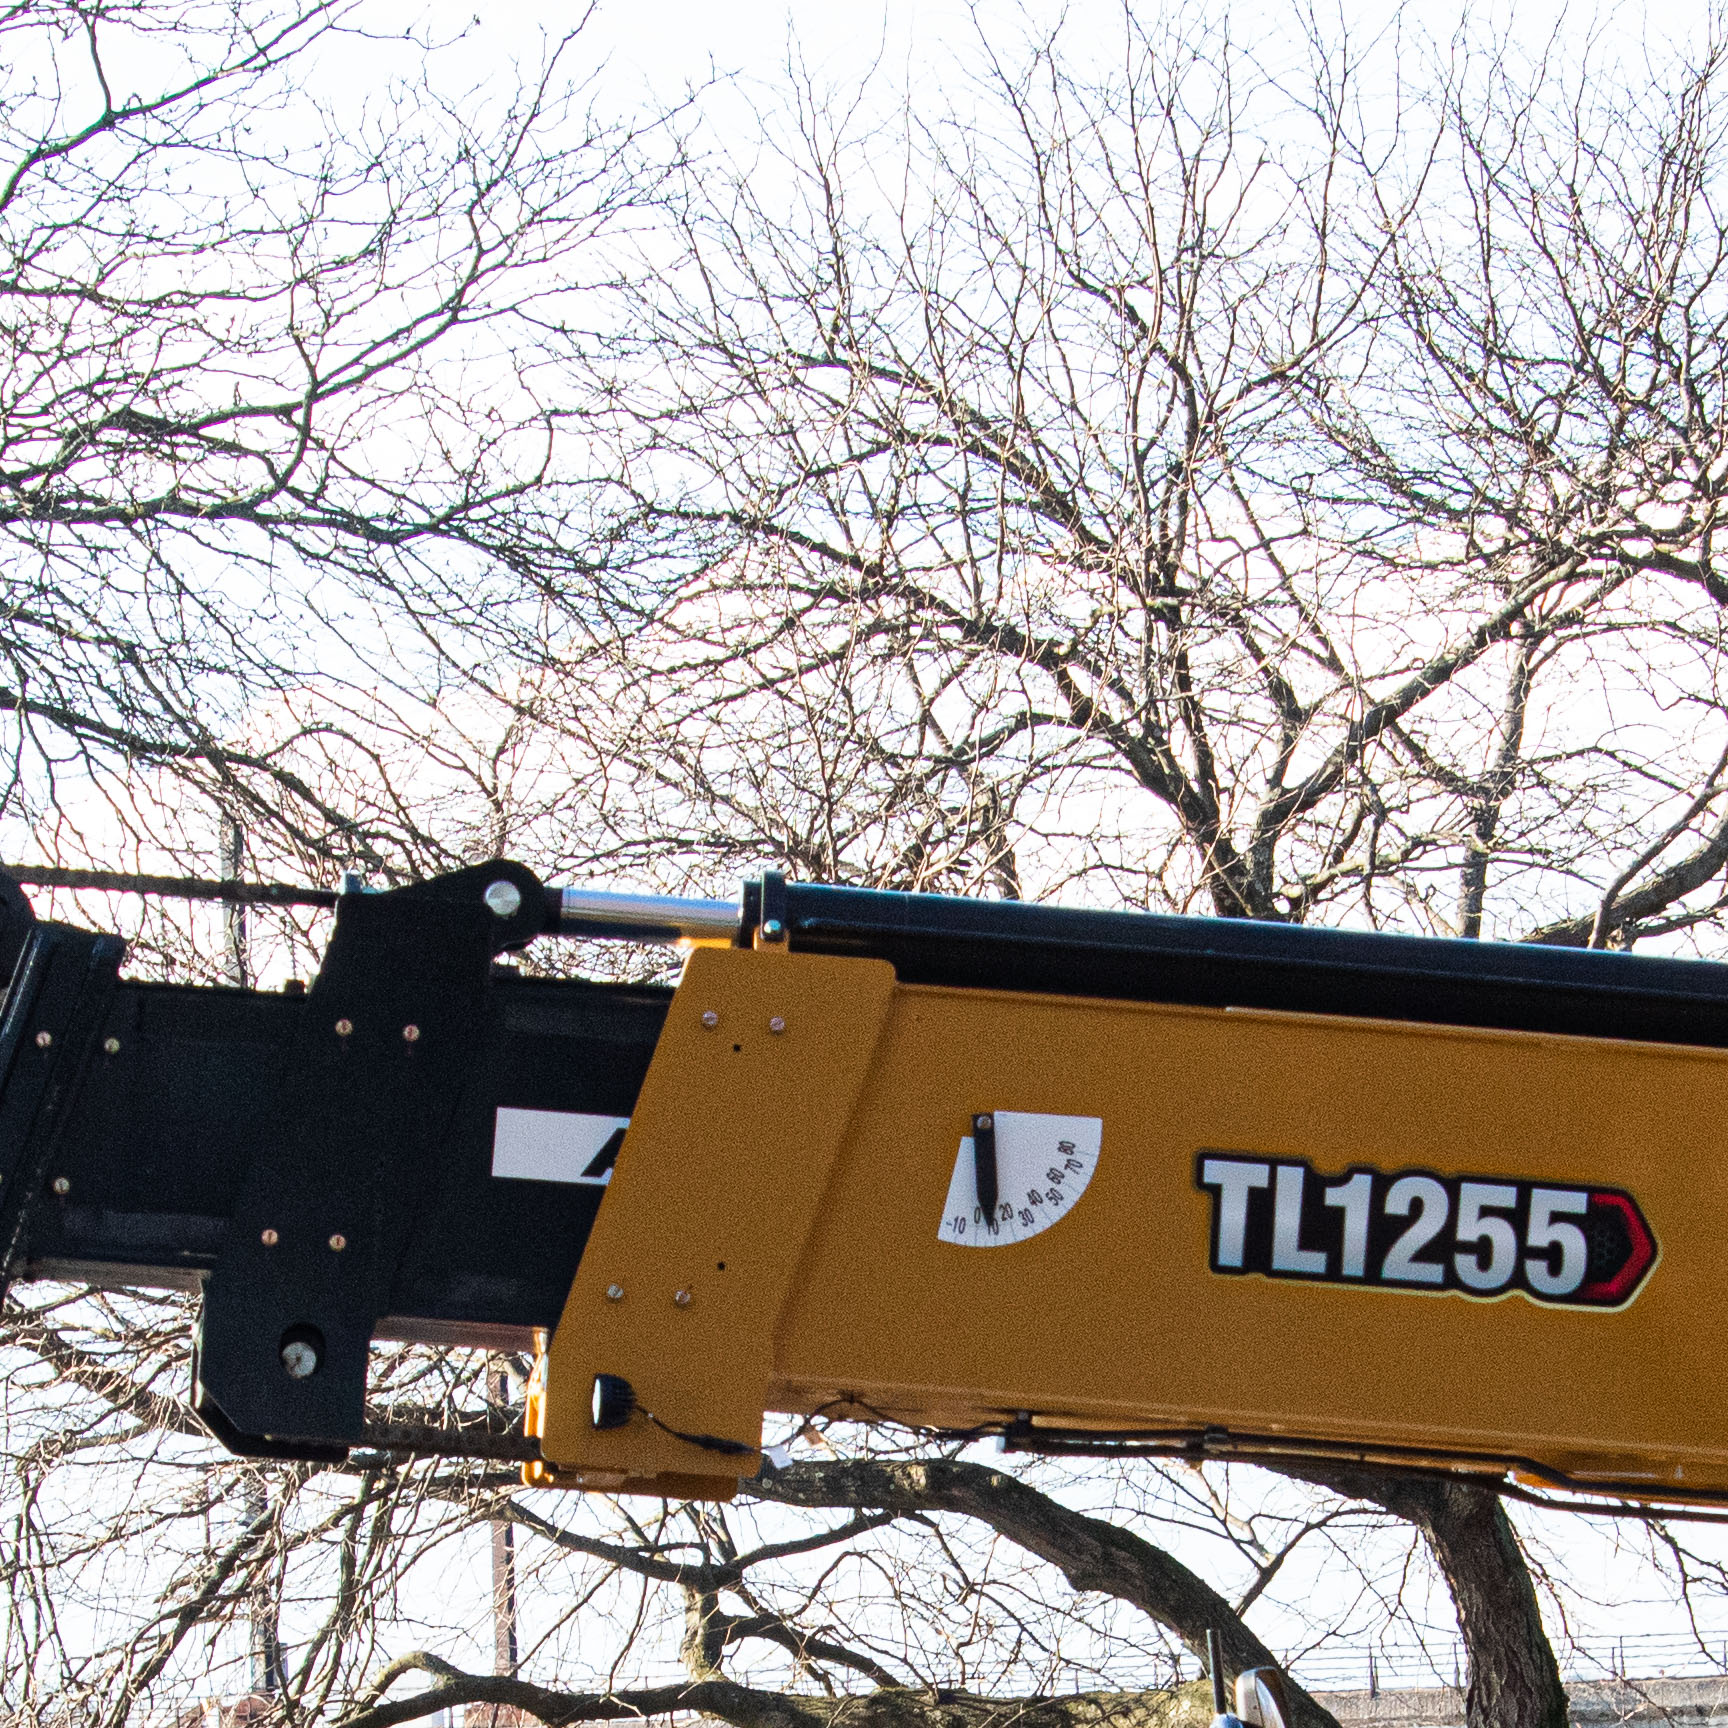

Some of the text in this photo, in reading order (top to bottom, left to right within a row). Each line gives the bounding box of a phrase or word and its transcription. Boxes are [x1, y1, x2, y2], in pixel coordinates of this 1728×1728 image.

[1057, 1140, 1076, 1156] 80
[1046, 1166, 1065, 1186] 60
[1064, 1158, 1084, 1175] 70
[1027, 1188, 1044, 1208] 40
[1045, 1187, 1064, 1206] 50
[999, 1202, 1014, 1222] 20
[1018, 1207, 1035, 1227] 30
[946, 1215, 966, 1235] -10
[1201, 1157, 1590, 1297] TL1255
